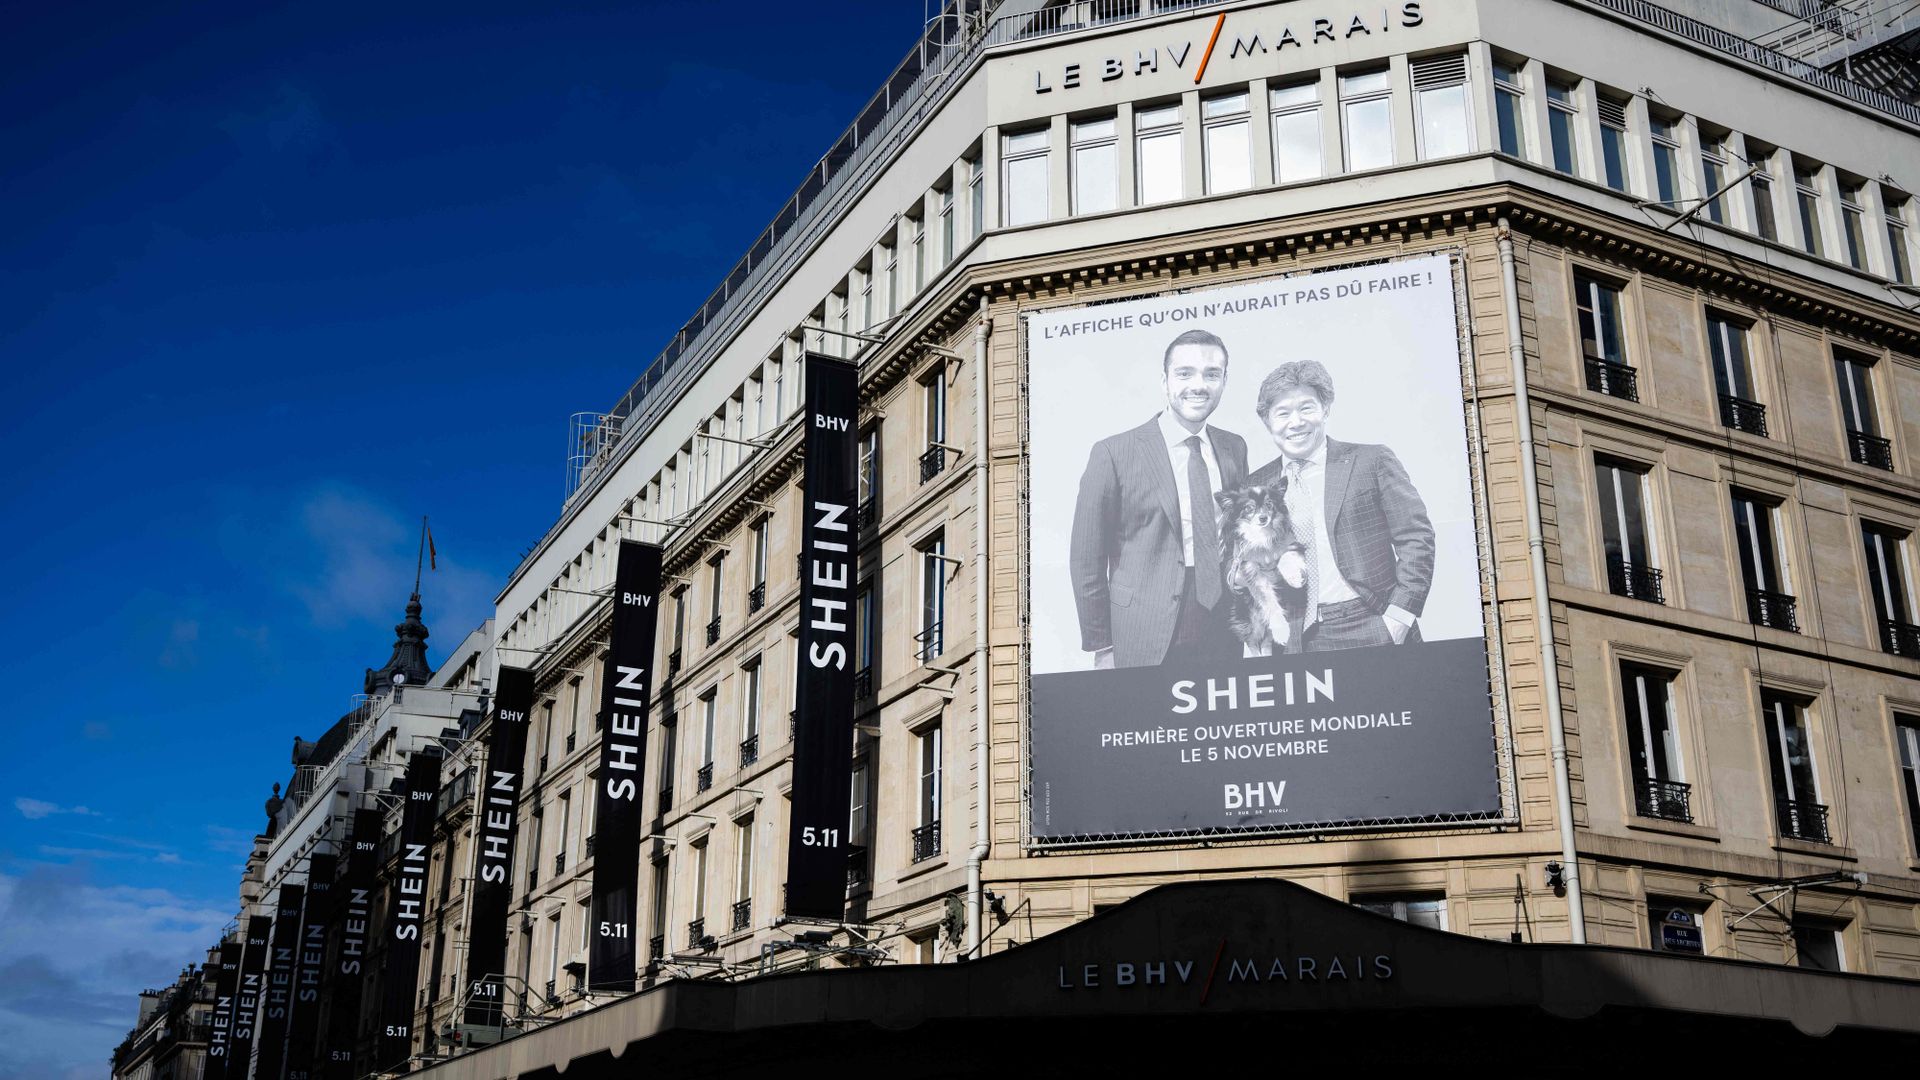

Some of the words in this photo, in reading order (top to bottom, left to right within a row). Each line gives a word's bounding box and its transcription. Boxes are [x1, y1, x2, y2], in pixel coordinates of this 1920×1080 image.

[1034, 63, 1081, 95] LE
[1044, 315, 1134, 340] L'AFFICHE
[1138, 306, 1198, 327] QU'ON
[1203, 293, 1289, 317] N'AURAIT
[1295, 287, 1332, 304] PAS
[1336, 279, 1362, 298] DÛ
[1368, 273, 1422, 294] FAIRE
[815, 413, 850, 433] BHV
[809, 500, 848, 672] SHEIN
[622, 591, 652, 608] BHV
[1171, 668, 1336, 714] SHEIN
[500, 709, 524, 723] BHV
[606, 664, 645, 802] SHEIN
[1101, 726, 1188, 747] PREMIÈRE
[1194, 719, 1305, 741] OUVERTURE
[1310, 711, 1412, 733] MONDIALE
[1181, 748, 1202, 763] LE
[1207, 747, 1219, 761] 5
[1224, 738, 1329, 760] NOVEMBRE
[412, 791, 433, 802] BHV
[1224, 780, 1286, 808] BHV
[482, 770, 516, 884] SHEIN
[802, 827, 838, 848] 5.11
[356, 841, 376, 851] BHV
[312, 882, 330, 892] BHV
[395, 843, 427, 941] SHEIN
[281, 908, 298, 918] BHV
[250, 938, 265, 947] BHV
[341, 888, 369, 976] SHEIN
[600, 921, 628, 939] 5.11
[222, 962, 237, 971] BHV
[300, 925, 325, 1002] SHEIN
[1059, 963, 1099, 989] LE
[269, 948, 292, 1019] SHEIN
[473, 982, 496, 997] 5.11
[236, 973, 260, 1040] SHEIN
[210, 996, 231, 1057] SHEIN
[386, 1025, 408, 1037] 5.11
[332, 1050, 351, 1062] 5.11
[290, 1070, 308, 1080] 5.11
